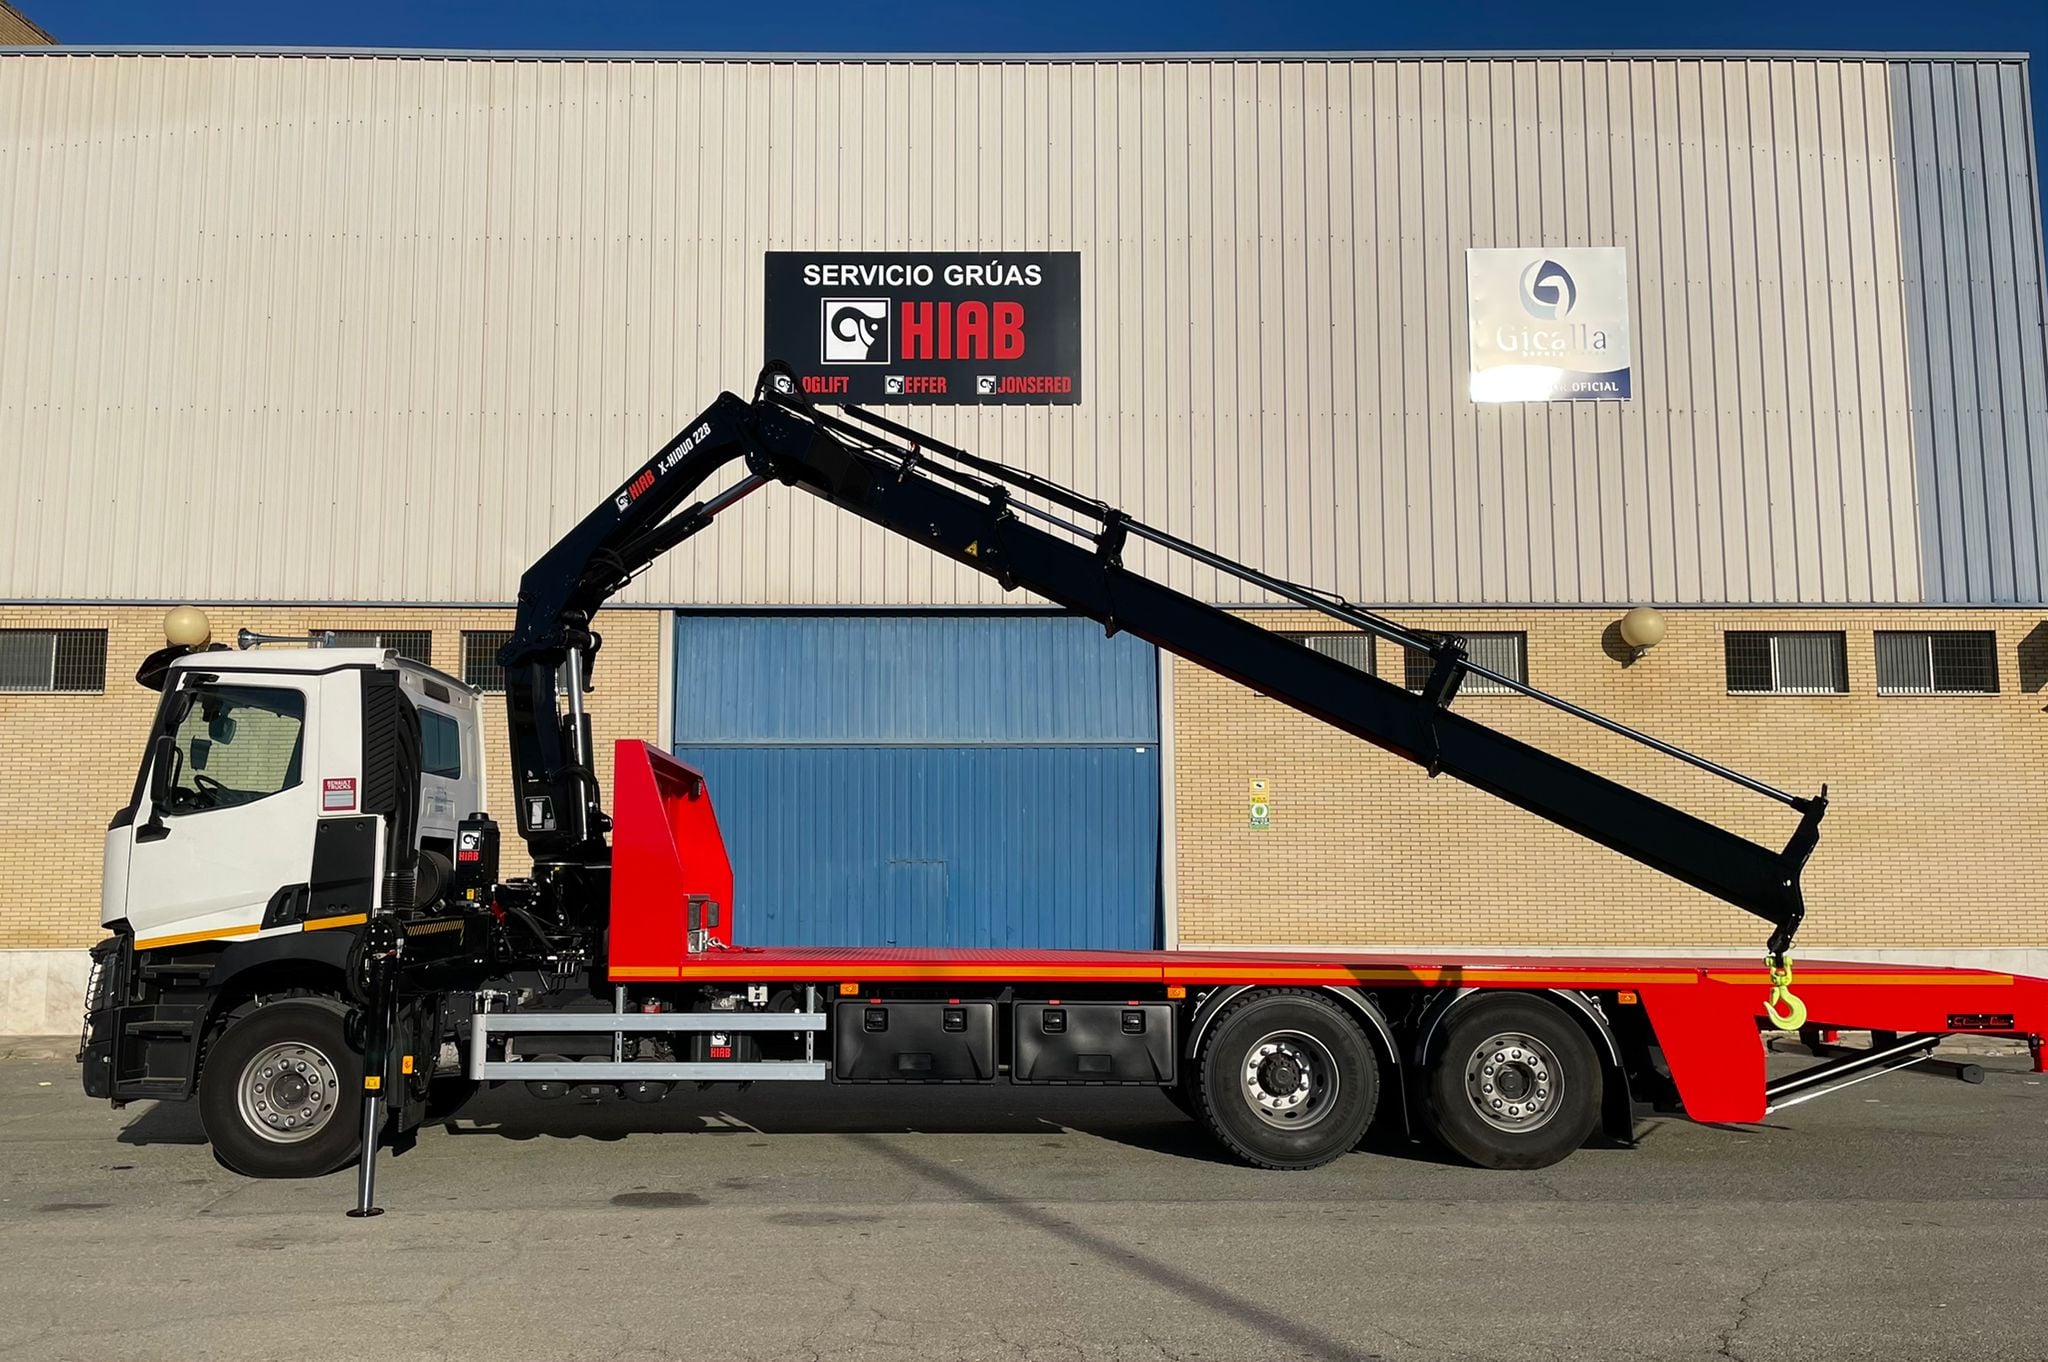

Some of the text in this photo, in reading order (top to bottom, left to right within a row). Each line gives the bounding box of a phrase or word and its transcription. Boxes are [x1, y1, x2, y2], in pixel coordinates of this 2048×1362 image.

[803, 260, 1042, 287] SERVICIO GRÚAS
[900, 301, 1026, 360] HIAB
[796, 375, 1072, 394] OGLIFT EFFER JONSERED
[1571, 382, 1619, 392] OFICIAL
[628, 422, 711, 500] HIAB X-HIDUO 228
[458, 851, 479, 861] HIAB
[711, 1047, 731, 1057] HIAB
